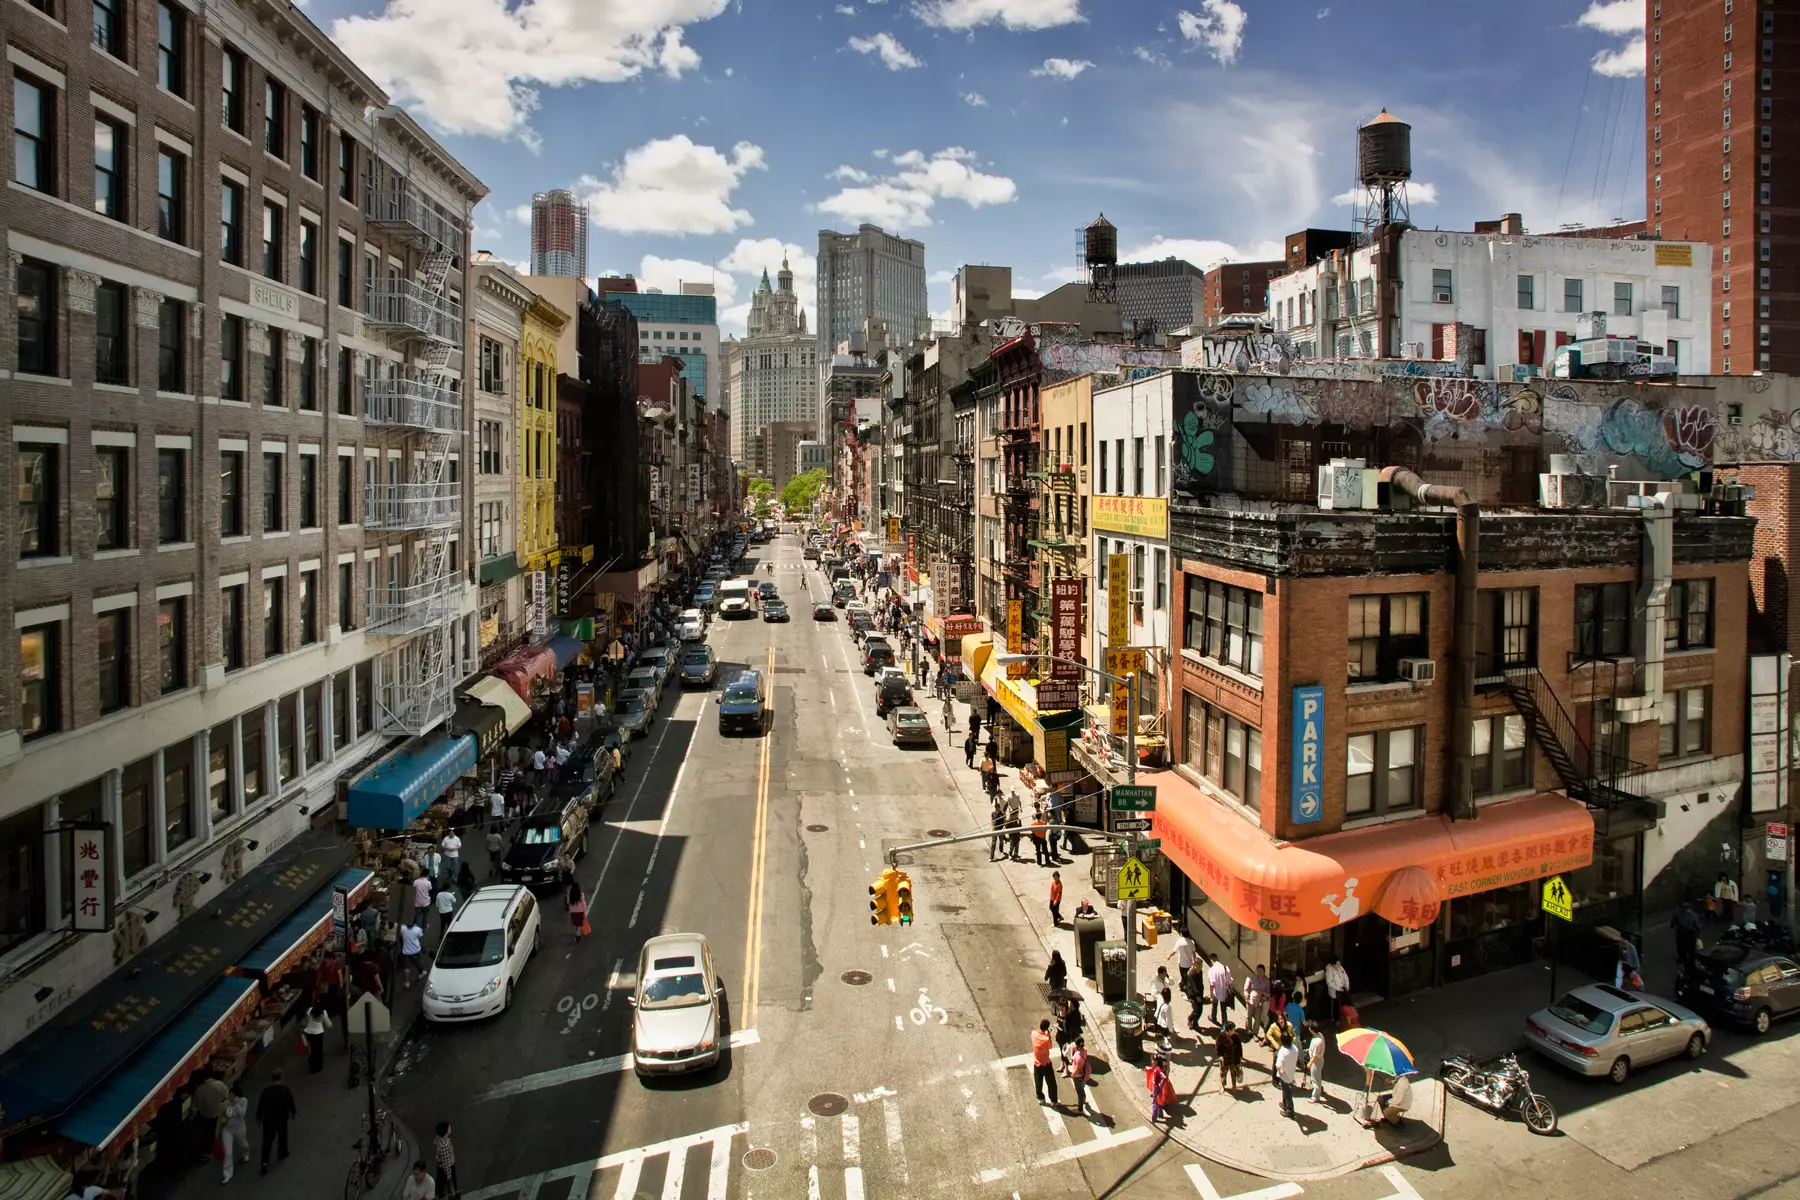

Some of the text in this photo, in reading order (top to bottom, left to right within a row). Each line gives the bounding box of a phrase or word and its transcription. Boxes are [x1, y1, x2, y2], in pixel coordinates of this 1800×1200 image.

[255, 286, 293, 311] SHEILS
[1131, 516, 1148, 525] SCHOOL
[1056, 584, 1078, 596] 紐約
[1009, 602, 1021, 611] 66
[1303, 699, 1318, 785] PARK
[1115, 789, 1153, 797] MANHATTAN
[80, 840, 100, 917] 兆豐行
[1448, 881, 1468, 895] EAST
[1470, 874, 1501, 890] CORNER
[1504, 866, 1535, 881] WONTON
[1240, 885, 1301, 917] 東旺
[1397, 897, 1438, 924] 東旺
[1546, 902, 1568, 916] AHEAD
[1262, 919, 1277, 929] 70
